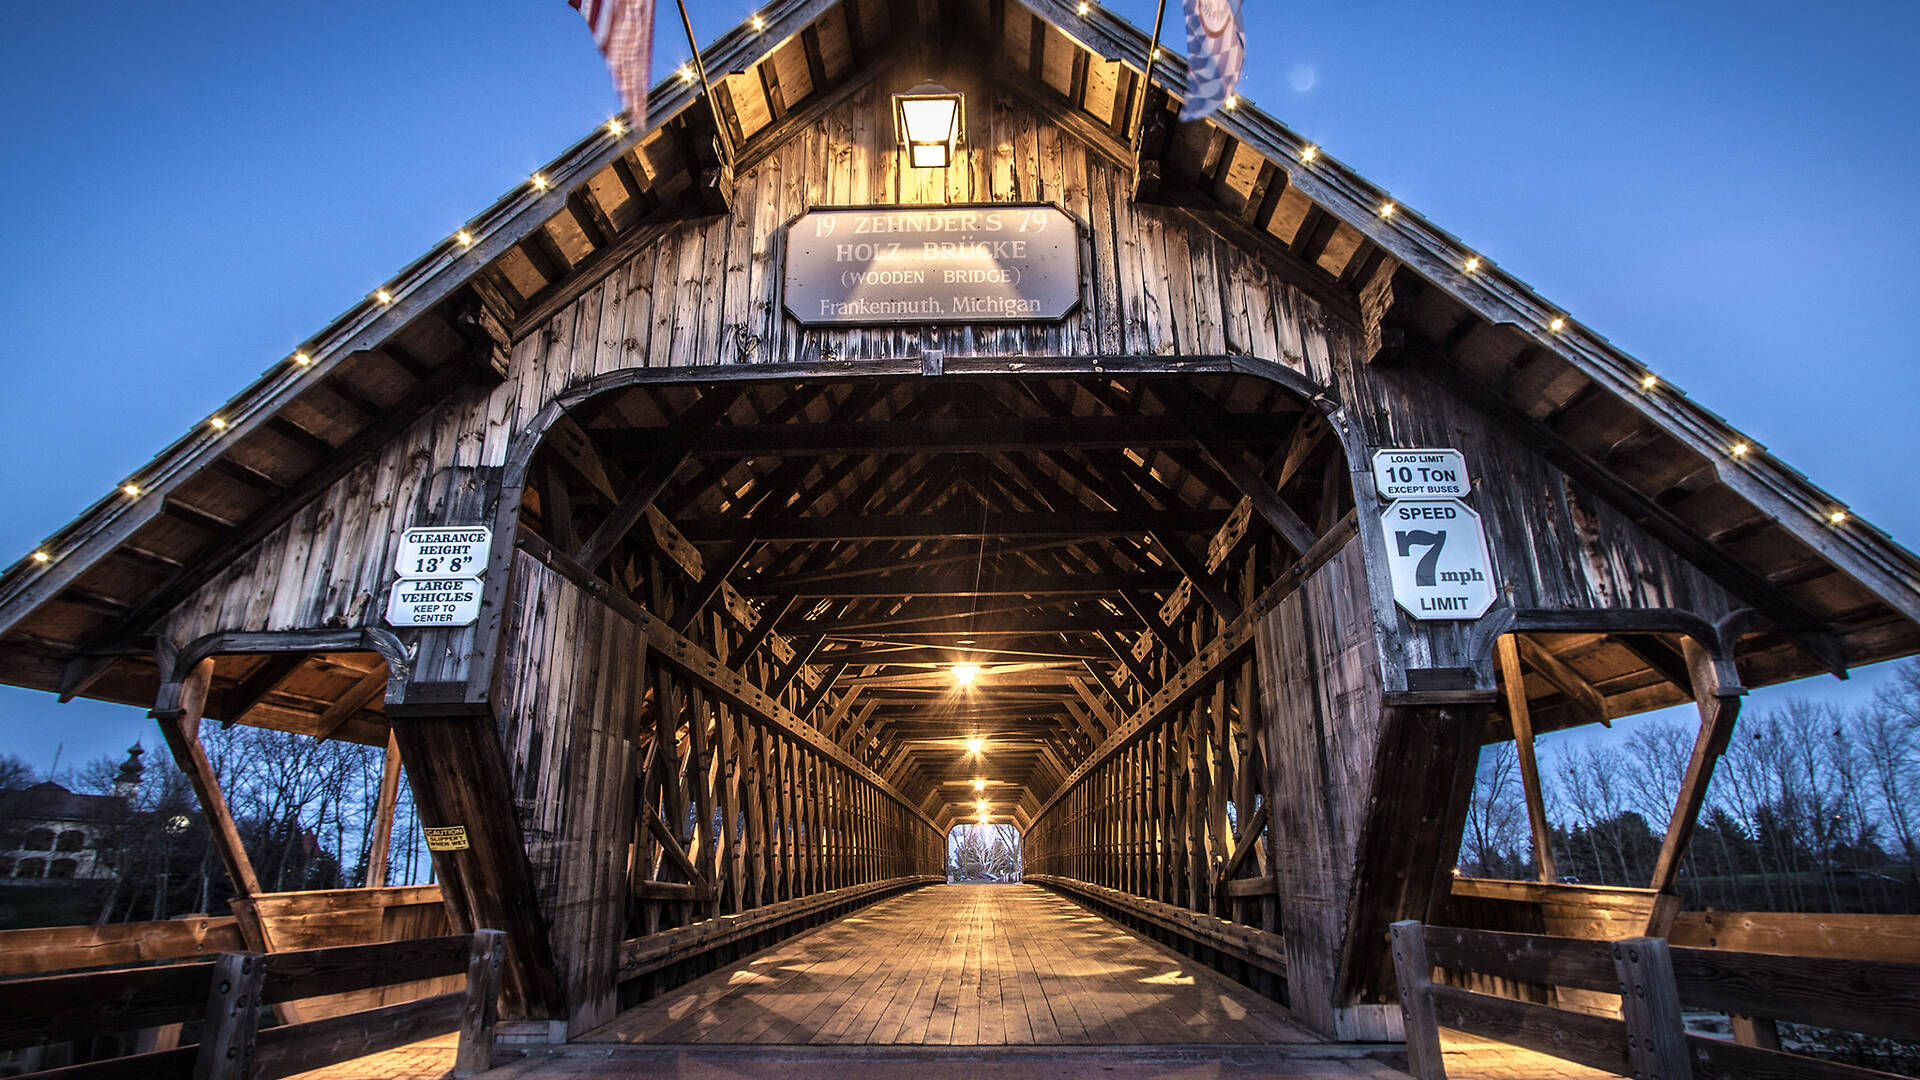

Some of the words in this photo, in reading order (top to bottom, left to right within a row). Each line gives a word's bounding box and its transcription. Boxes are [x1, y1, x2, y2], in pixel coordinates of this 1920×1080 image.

[816, 216, 836, 237] 19
[855, 213, 1003, 234] ZEHNDER'S
[1017, 211, 1047, 233] 79
[836, 243, 899, 262] HOLZ
[922, 235, 1026, 260] BRÜCKE
[841, 270, 925, 288] (WOODEN
[943, 266, 1021, 286] BRIDGE)
[820, 299, 944, 316] Frankenmuth,
[952, 297, 1041, 318] Michigan
[1386, 467, 1412, 483] 10
[1388, 486, 1424, 494] EXCEPT
[1428, 486, 1460, 494] BUSES
[1400, 508, 1456, 520] SPEED
[409, 534, 486, 544] CLEARANCE
[420, 545, 471, 555] HEIGHT
[1395, 530, 1446, 586] 7
[1440, 568, 1484, 585] mph
[415, 582, 464, 591] LARGE
[402, 592, 474, 602] VEHICLES
[442, 604, 456, 612] TO
[1420, 598, 1468, 610] LIMIT
[413, 614, 453, 622] CENTER
